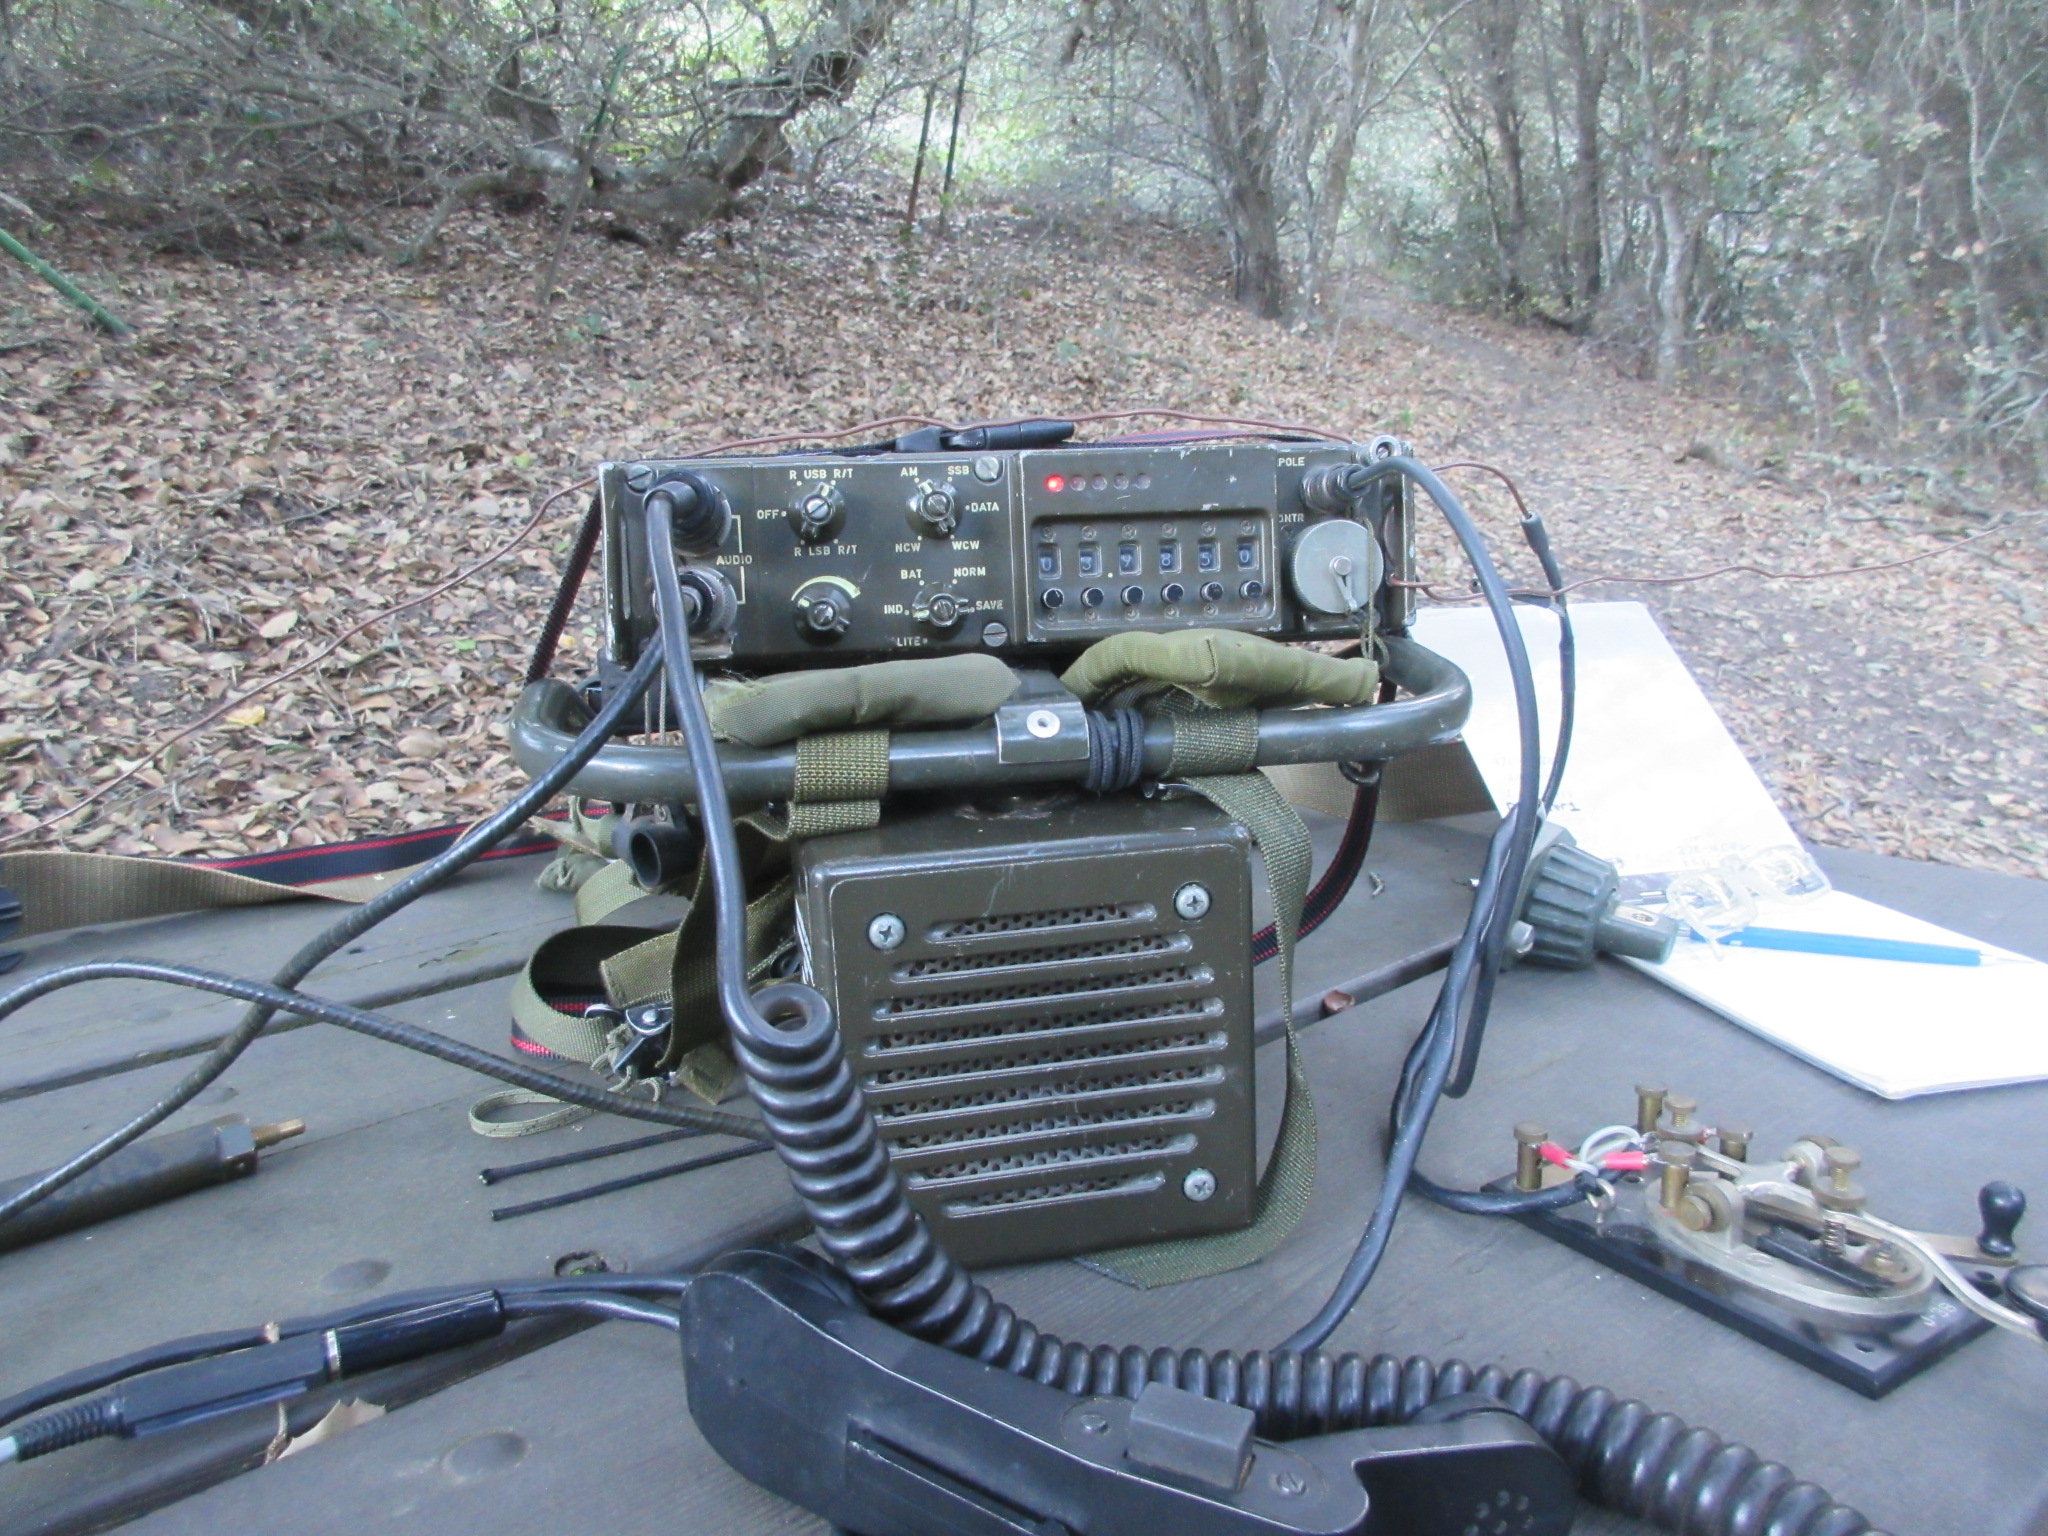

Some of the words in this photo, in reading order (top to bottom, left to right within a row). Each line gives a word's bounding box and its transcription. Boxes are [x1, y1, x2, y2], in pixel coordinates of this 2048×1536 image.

[1278, 457, 1305, 466] POLE
[789, 470, 797, 479] R
[804, 470, 827, 479] USB
[834, 468, 853, 479] R/T
[900, 468, 918, 477] AM
[948, 466, 970, 475] SSB
[971, 502, 999, 512] DATA
[757, 510, 778, 519] OFF
[895, 543, 921, 553] NCW
[952, 540, 980, 550] WCW
[795, 547, 801, 556] R
[809, 546, 831, 556] LSB
[838, 545, 857, 555] R/T
[717, 555, 752, 565] AUDIO
[1041, 557, 1051, 571] 0
[1081, 556, 1091, 570] 3
[1121, 554, 1131, 568] 9
[1161, 553, 1171, 566] 8
[1201, 551, 1211, 566] 5
[1240, 549, 1249, 563] 0
[900, 569, 922, 579] BAT
[954, 567, 986, 576] NORM
[884, 604, 902, 614] IND
[976, 600, 1003, 610] SAVE
[897, 636, 920, 646] LITE
